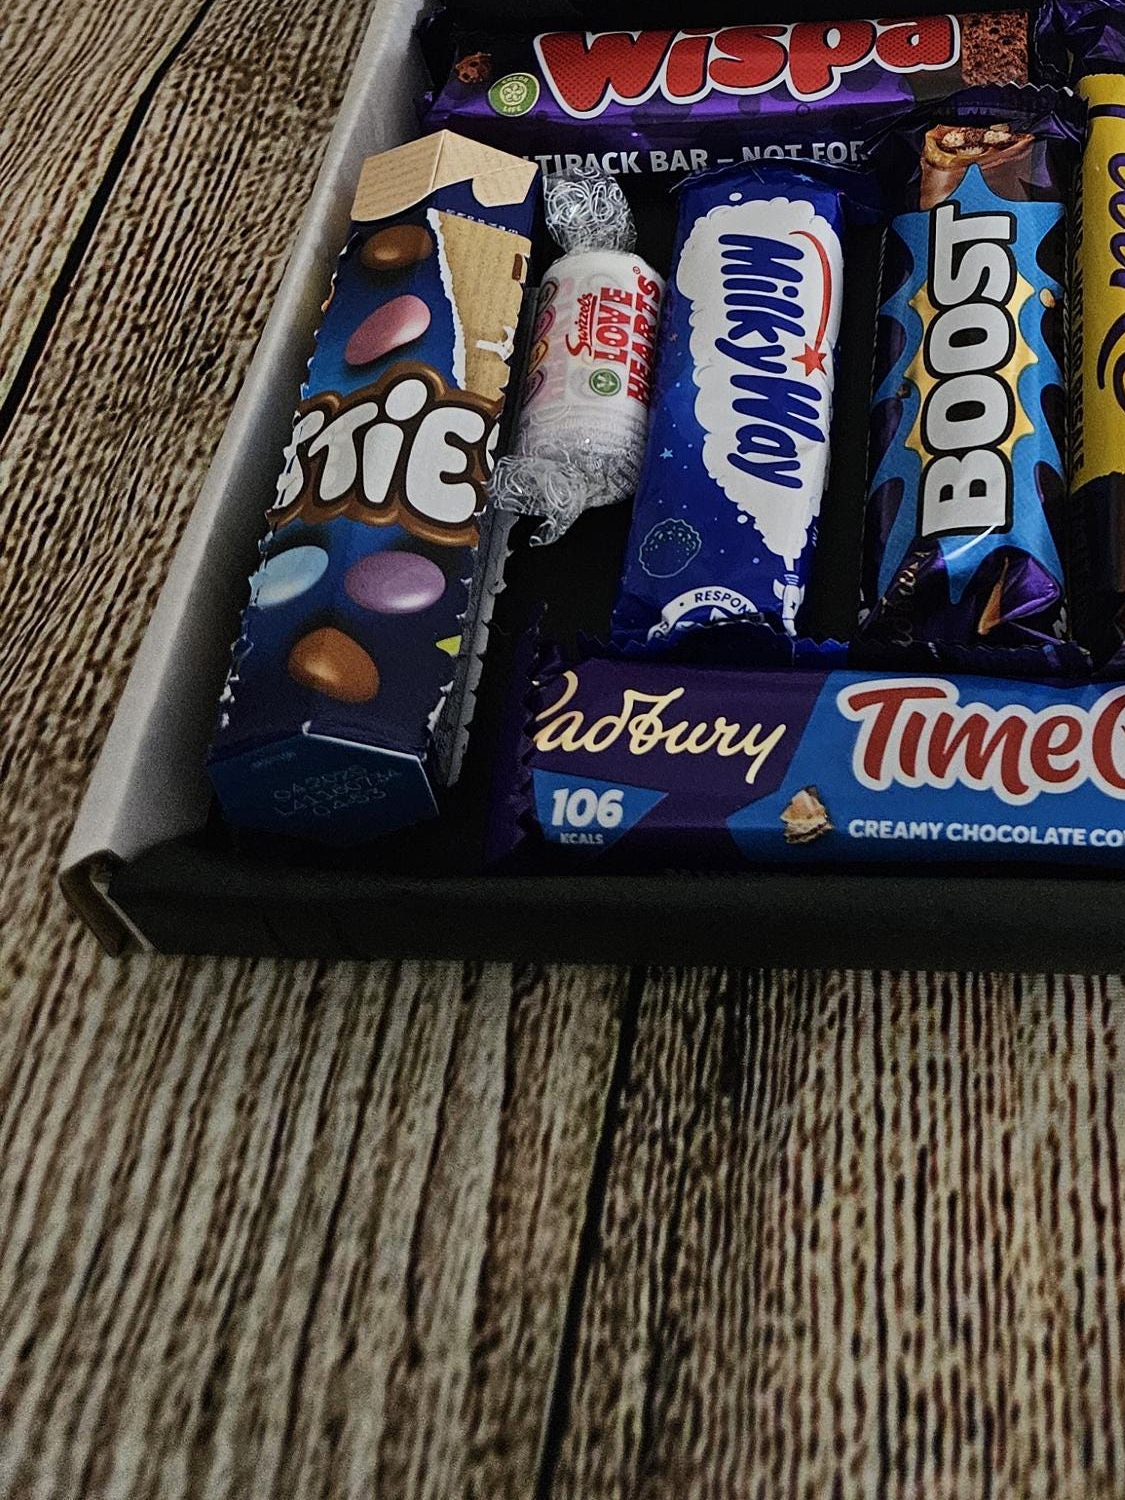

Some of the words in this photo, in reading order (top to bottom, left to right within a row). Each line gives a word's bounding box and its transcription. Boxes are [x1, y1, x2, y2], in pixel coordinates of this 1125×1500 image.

[534, 13, 960, 118] Wispa
[649, 148, 709, 173] BAR
[566, 292, 598, 356] Swizzels
[594, 287, 634, 365] LOVE
[627, 274, 662, 411] HEARTS
[922, 202, 1014, 537] BOOST
[551, 787, 625, 828] 106
[560, 832, 604, 845] KCALS
[848, 818, 945, 841] CREAMY
[946, 823, 1088, 847] CHOCOLATE
